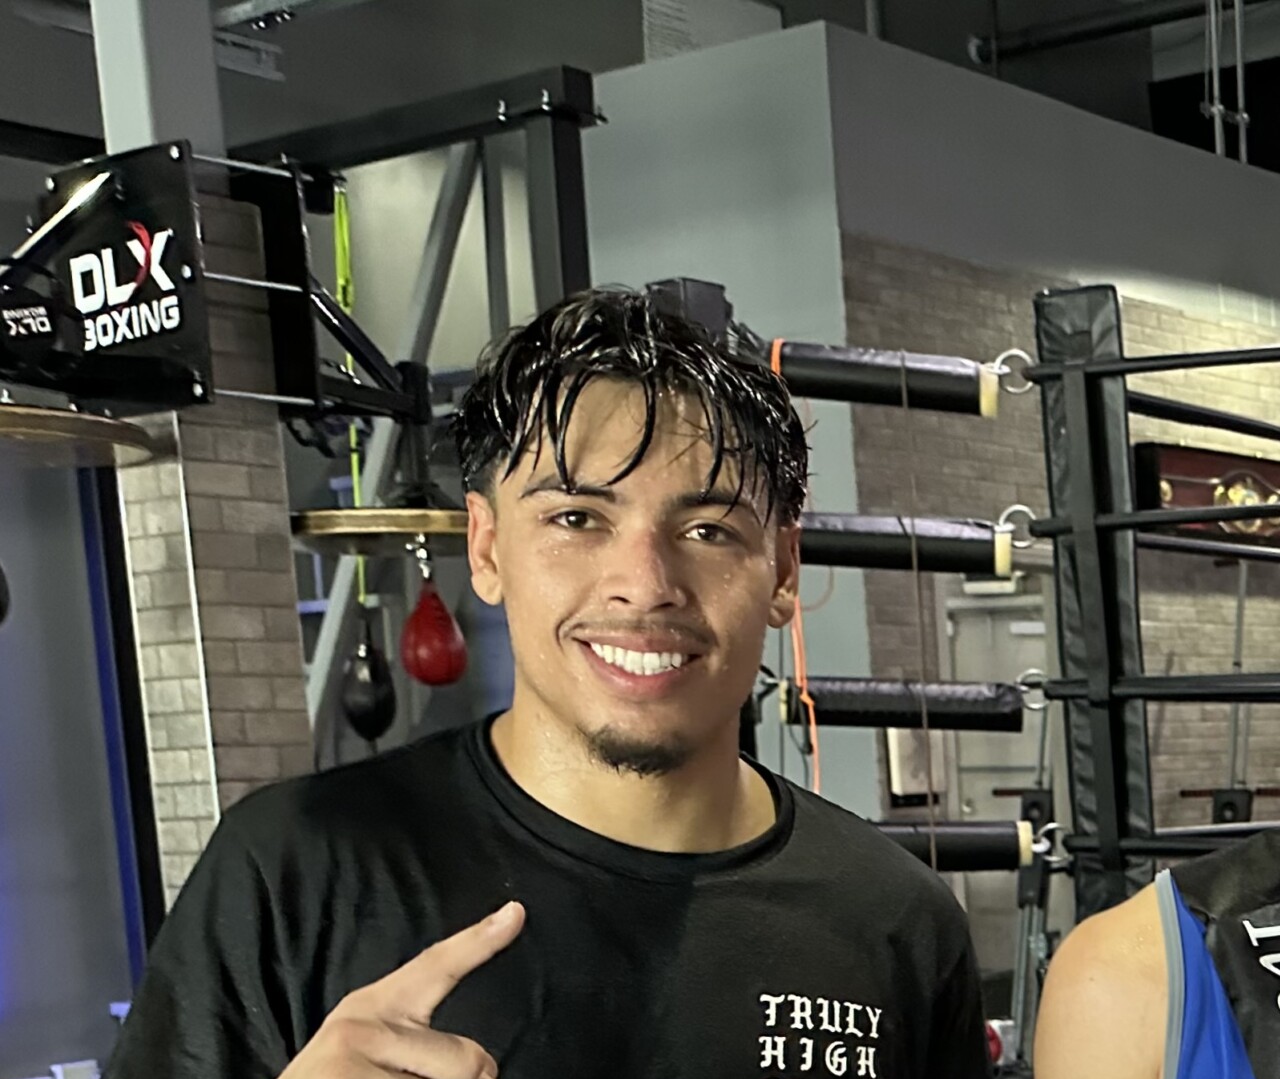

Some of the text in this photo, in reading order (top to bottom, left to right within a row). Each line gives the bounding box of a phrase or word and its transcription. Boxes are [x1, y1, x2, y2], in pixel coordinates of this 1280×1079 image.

[69, 221, 176, 315] DLX
[759, 994, 883, 1039] TRULY
[758, 1036, 877, 1079] HIGH
